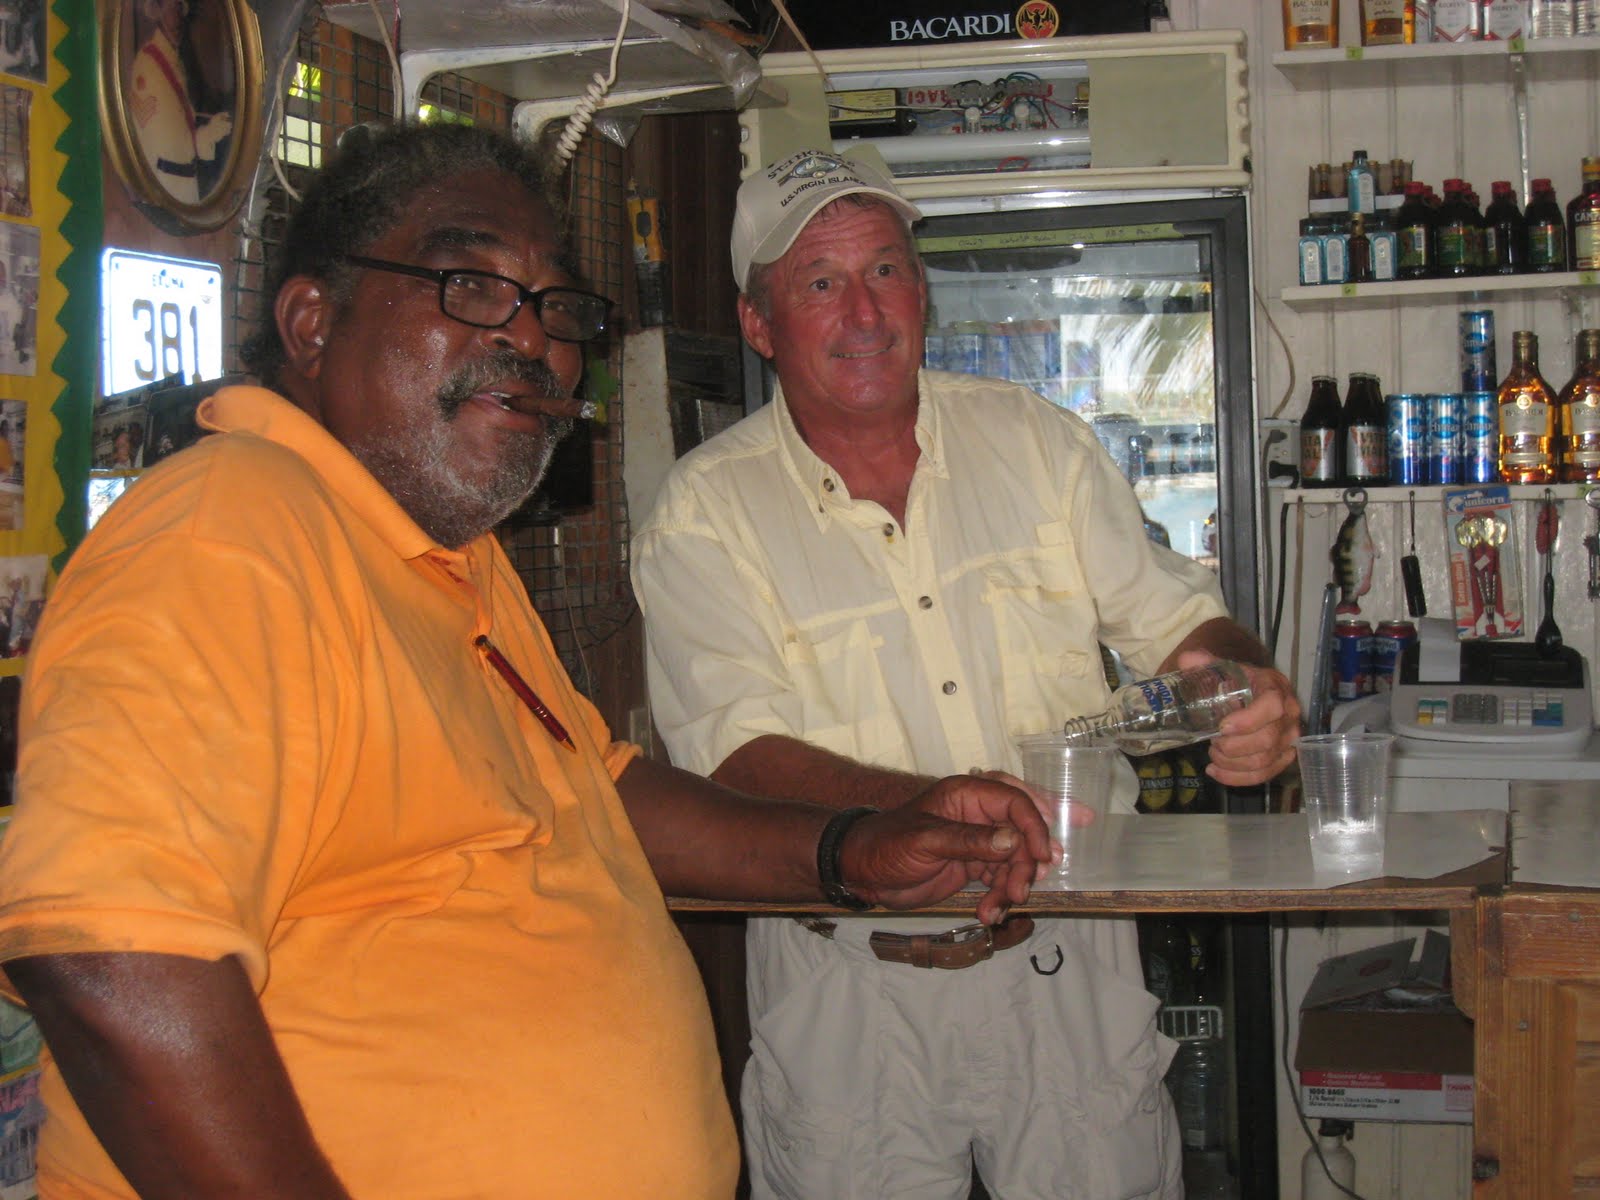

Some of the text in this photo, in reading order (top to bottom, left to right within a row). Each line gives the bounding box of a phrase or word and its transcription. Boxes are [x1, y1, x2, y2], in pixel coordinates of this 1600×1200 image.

[890, 13, 1011, 41] BACARDI
[1574, 212, 1600, 222] CAMP
[132, 298, 202, 384] 381
[1464, 495, 1505, 507] unicorn
[1139, 777, 1175, 790] UINNESS
